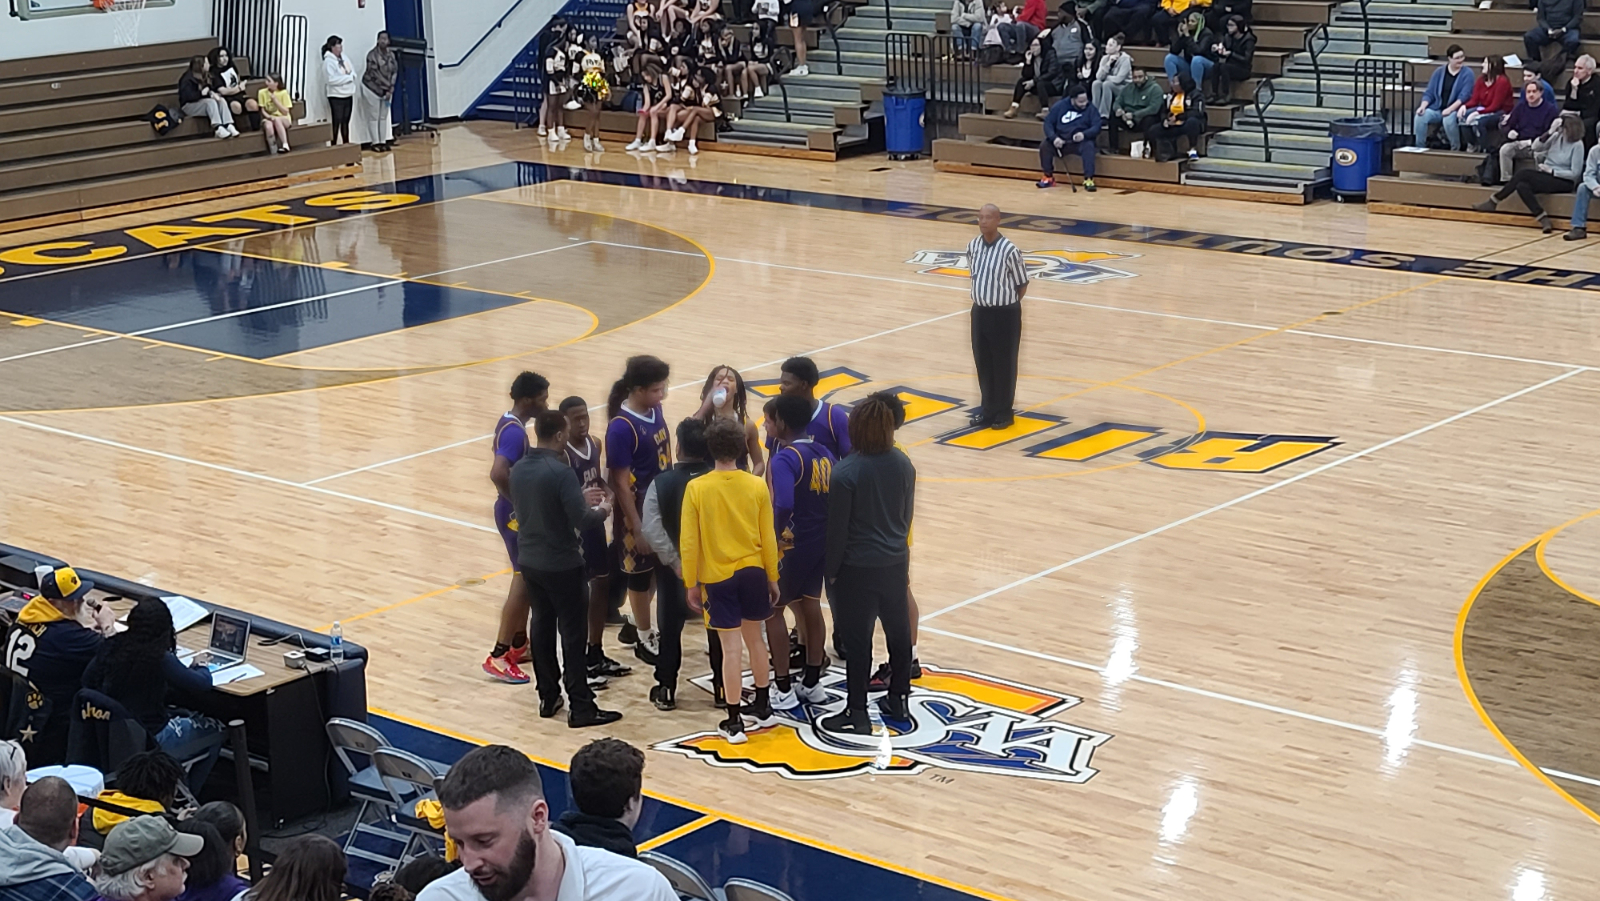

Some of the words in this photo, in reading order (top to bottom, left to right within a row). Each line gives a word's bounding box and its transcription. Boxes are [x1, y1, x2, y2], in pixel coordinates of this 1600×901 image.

[0, 191, 420, 277] CATS
[1096, 225, 1417, 268] SOUTH
[1440, 262, 1600, 291] HE
[809, 456, 831, 495] 40
[6, 628, 36, 677] 12
